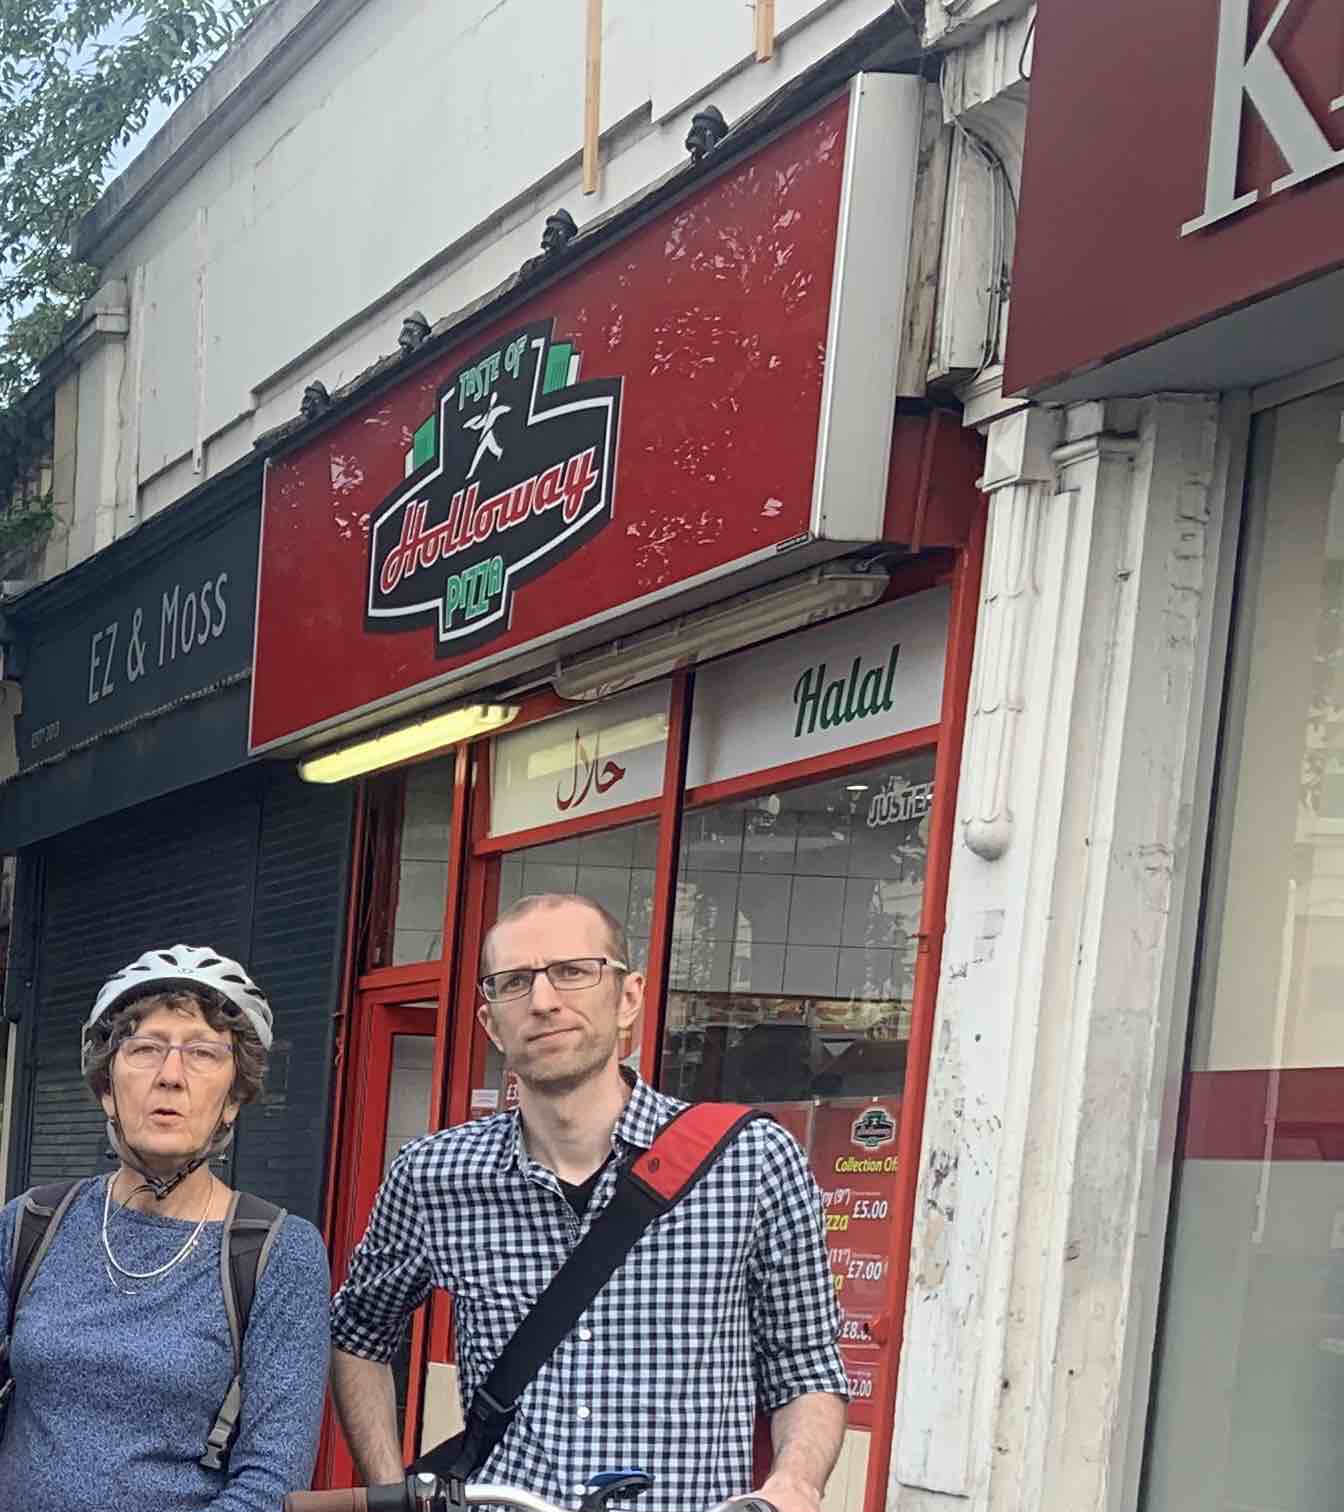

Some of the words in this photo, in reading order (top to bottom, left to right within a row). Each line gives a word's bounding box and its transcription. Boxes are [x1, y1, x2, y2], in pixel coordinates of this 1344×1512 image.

[1180, 0, 1344, 238] K
[458, 351, 501, 412] TASTE
[504, 334, 528, 380] OF
[380, 446, 600, 595] Holloway
[445, 555, 504, 629] PIZZA
[88, 621, 119, 705] EZ
[127, 607, 148, 683] &
[792, 643, 902, 739] Halal
[556, 728, 626, 811] حلال
[835, 1156, 884, 1174] Collection
[851, 1199, 888, 1219] £5.00
[846, 1258, 882, 1281] £7.00
